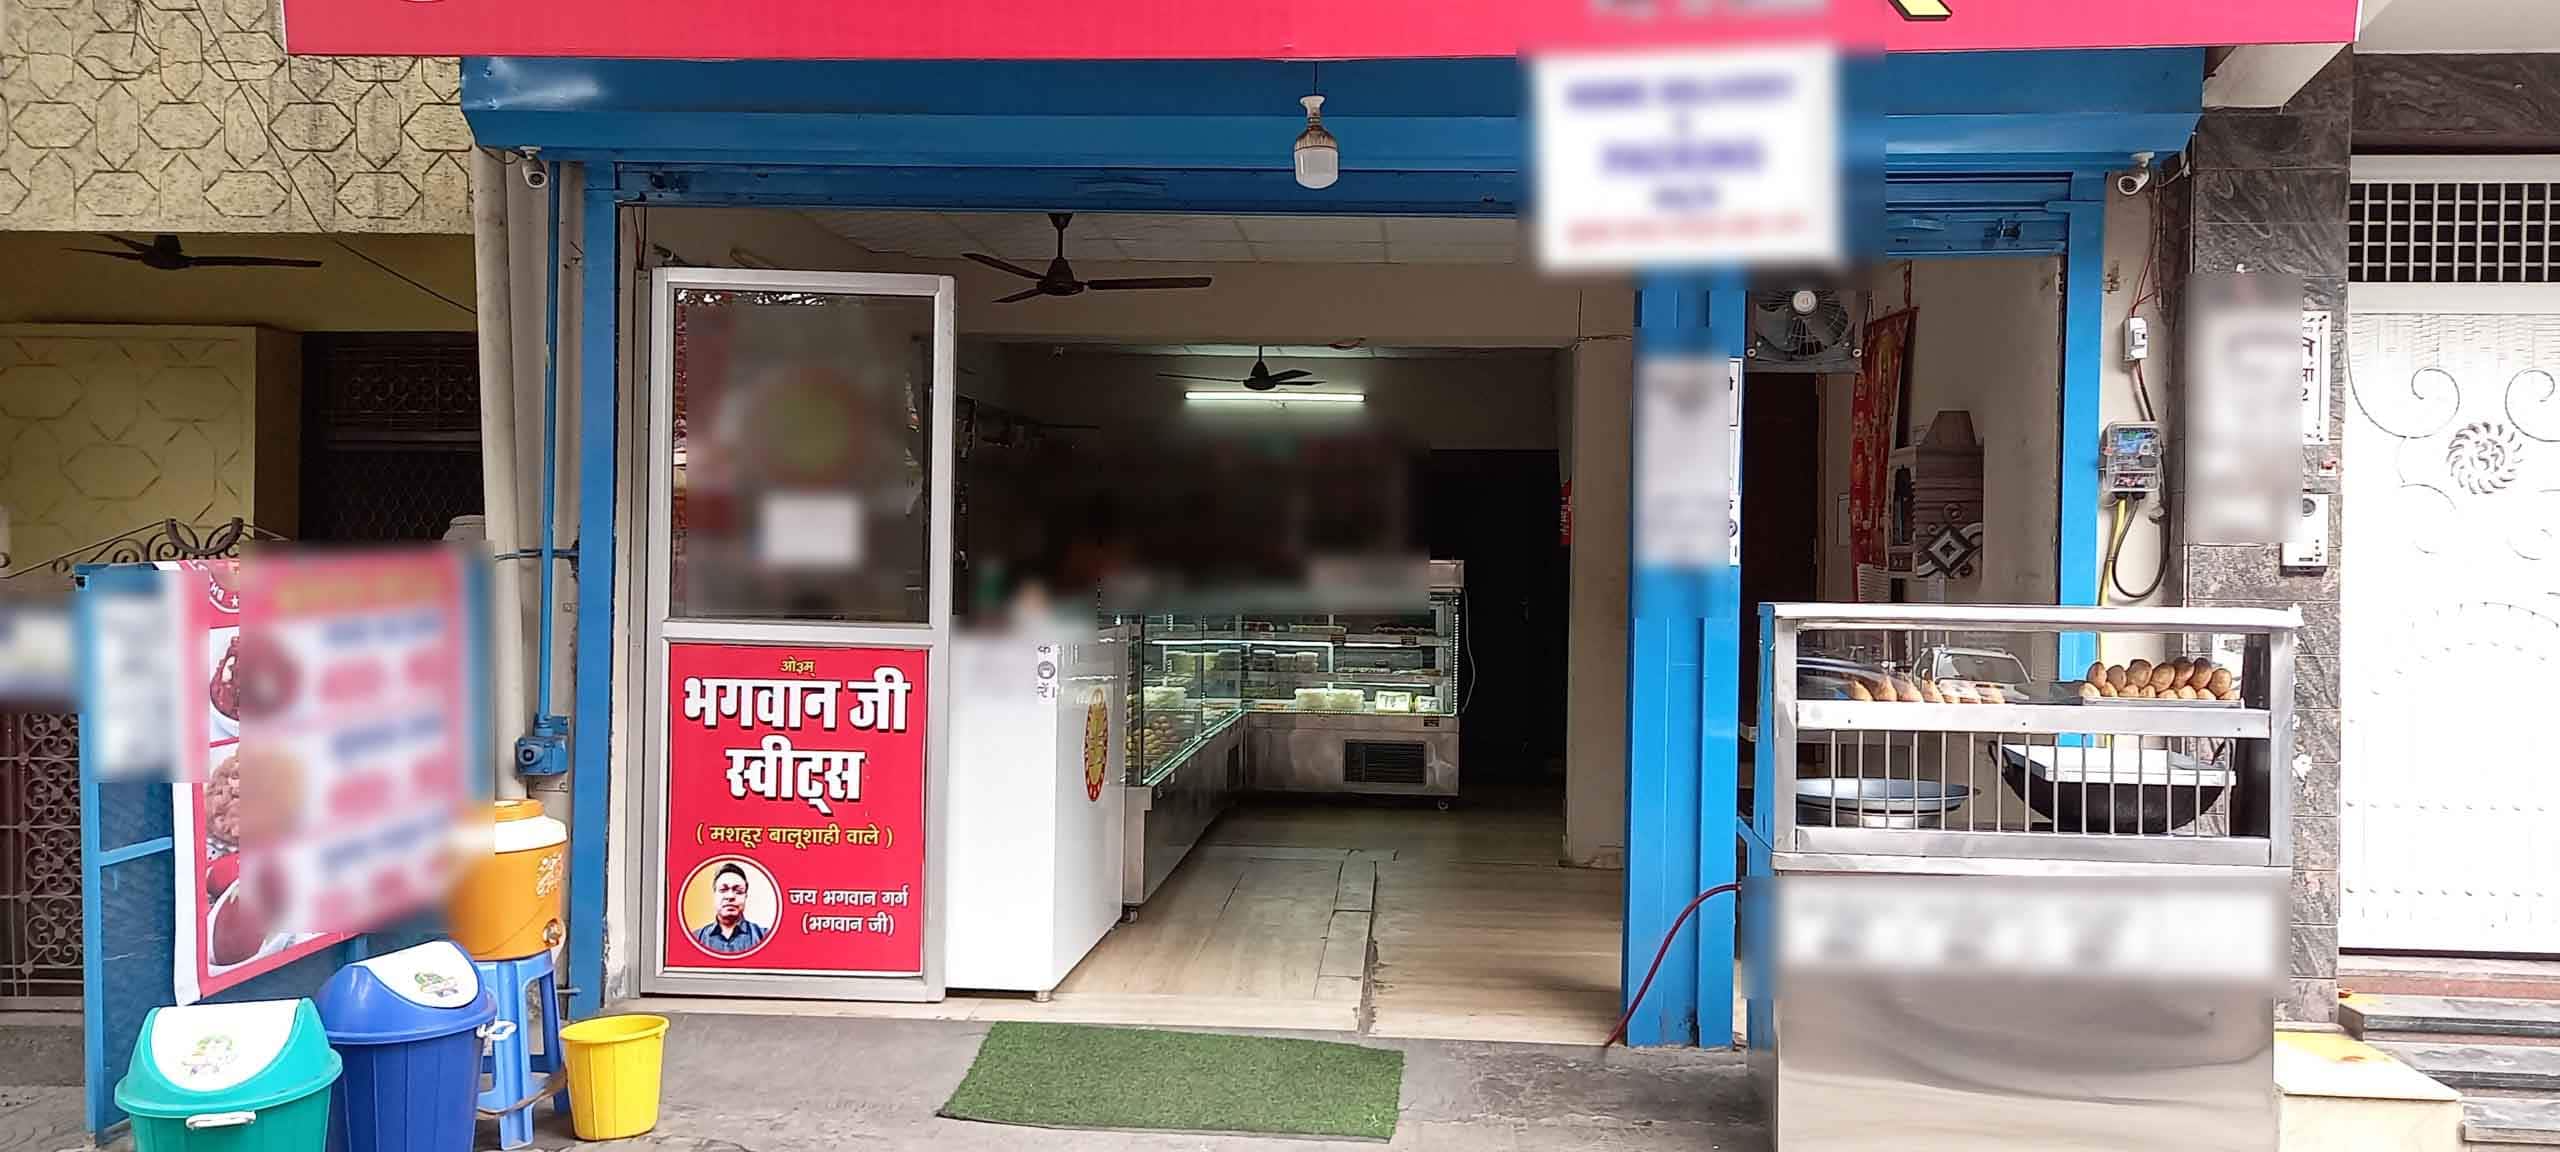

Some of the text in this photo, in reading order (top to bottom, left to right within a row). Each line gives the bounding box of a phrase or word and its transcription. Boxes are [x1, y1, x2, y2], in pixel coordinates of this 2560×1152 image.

[684, 666, 912, 732] भगवान जी
[725, 734, 866, 815] स्वीट्स
[709, 826, 763, 849] मशहूर
[767, 824, 841, 849] बालूशाही
[845, 825, 880, 846] वाले
[788, 884, 909, 907] जय भगवान गर्ग
[802, 911, 895, 936] (भगवान जी)
